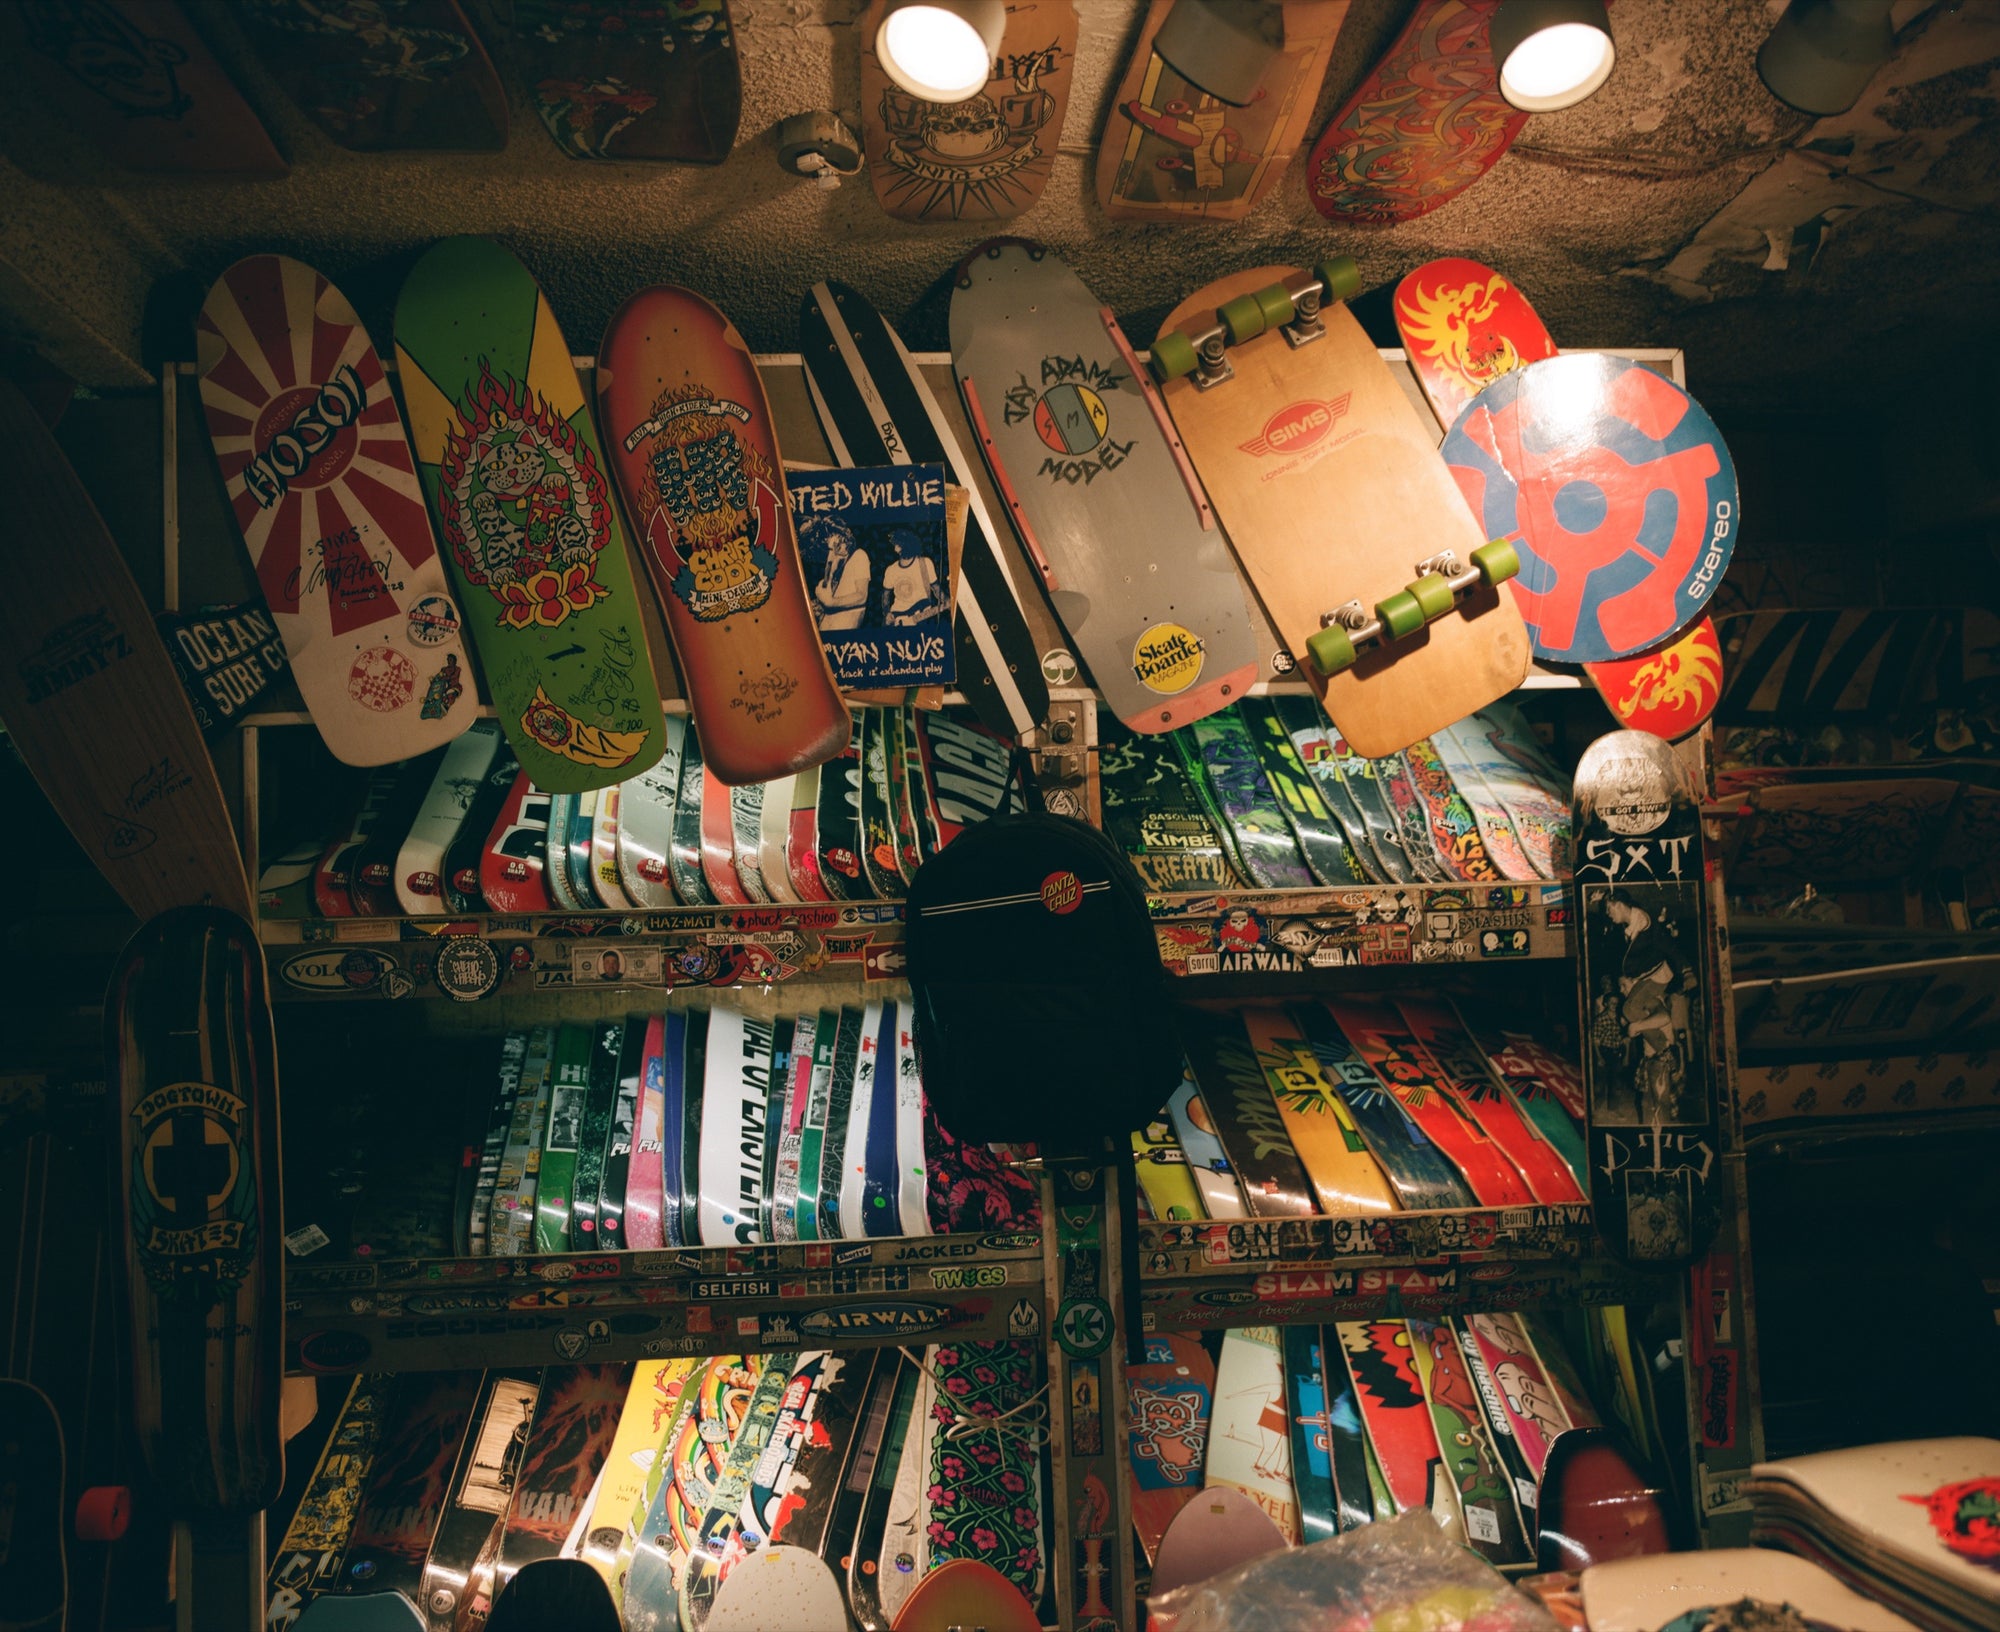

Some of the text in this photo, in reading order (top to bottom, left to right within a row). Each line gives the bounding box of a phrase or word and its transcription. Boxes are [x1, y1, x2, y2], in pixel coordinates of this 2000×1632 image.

[1041, 353, 1132, 392] ADAMS
[725, 402, 746, 419] ALVA
[243, 364, 368, 510] HOSOI
[630, 425, 649, 446] ALVA
[1268, 407, 1329, 446] SIMS
[1037, 438, 1139, 486] MODEL
[859, 478, 945, 510] WILLIE
[1686, 500, 1733, 600] stereo
[175, 607, 273, 672] OCEAN
[832, 632, 945, 665] VAN NUYS
[1138, 632, 1188, 665] Skate
[880, 665, 923, 678] extended
[925, 663, 944, 678] play
[1132, 638, 1206, 683] Boarder
[1152, 658, 1198, 686] MAGAZINE
[203, 648, 268, 717] SURF
[626, 718, 643, 731] 100
[1040, 872, 1076, 901] SANTA
[1049, 886, 1077, 912] CRUZ
[1239, 894, 1278, 902] JACKED
[649, 914, 714, 929] HAZ-MAT
[746, 909, 783, 929] phuck
[141, 1086, 236, 1118] DOGTOWN
[152, 1221, 240, 1253] SKATES
[837, 1246, 871, 1263] Shorty's
[893, 1243, 978, 1261] JACKED
[698, 1281, 771, 1298] SELFISH
[1256, 1273, 1354, 1296] SLAM
[1362, 1268, 1457, 1290] SLAM
[753, 1380, 807, 1487] REAL SKATEBOARDS
[959, 1483, 1009, 1506] CHIMA
